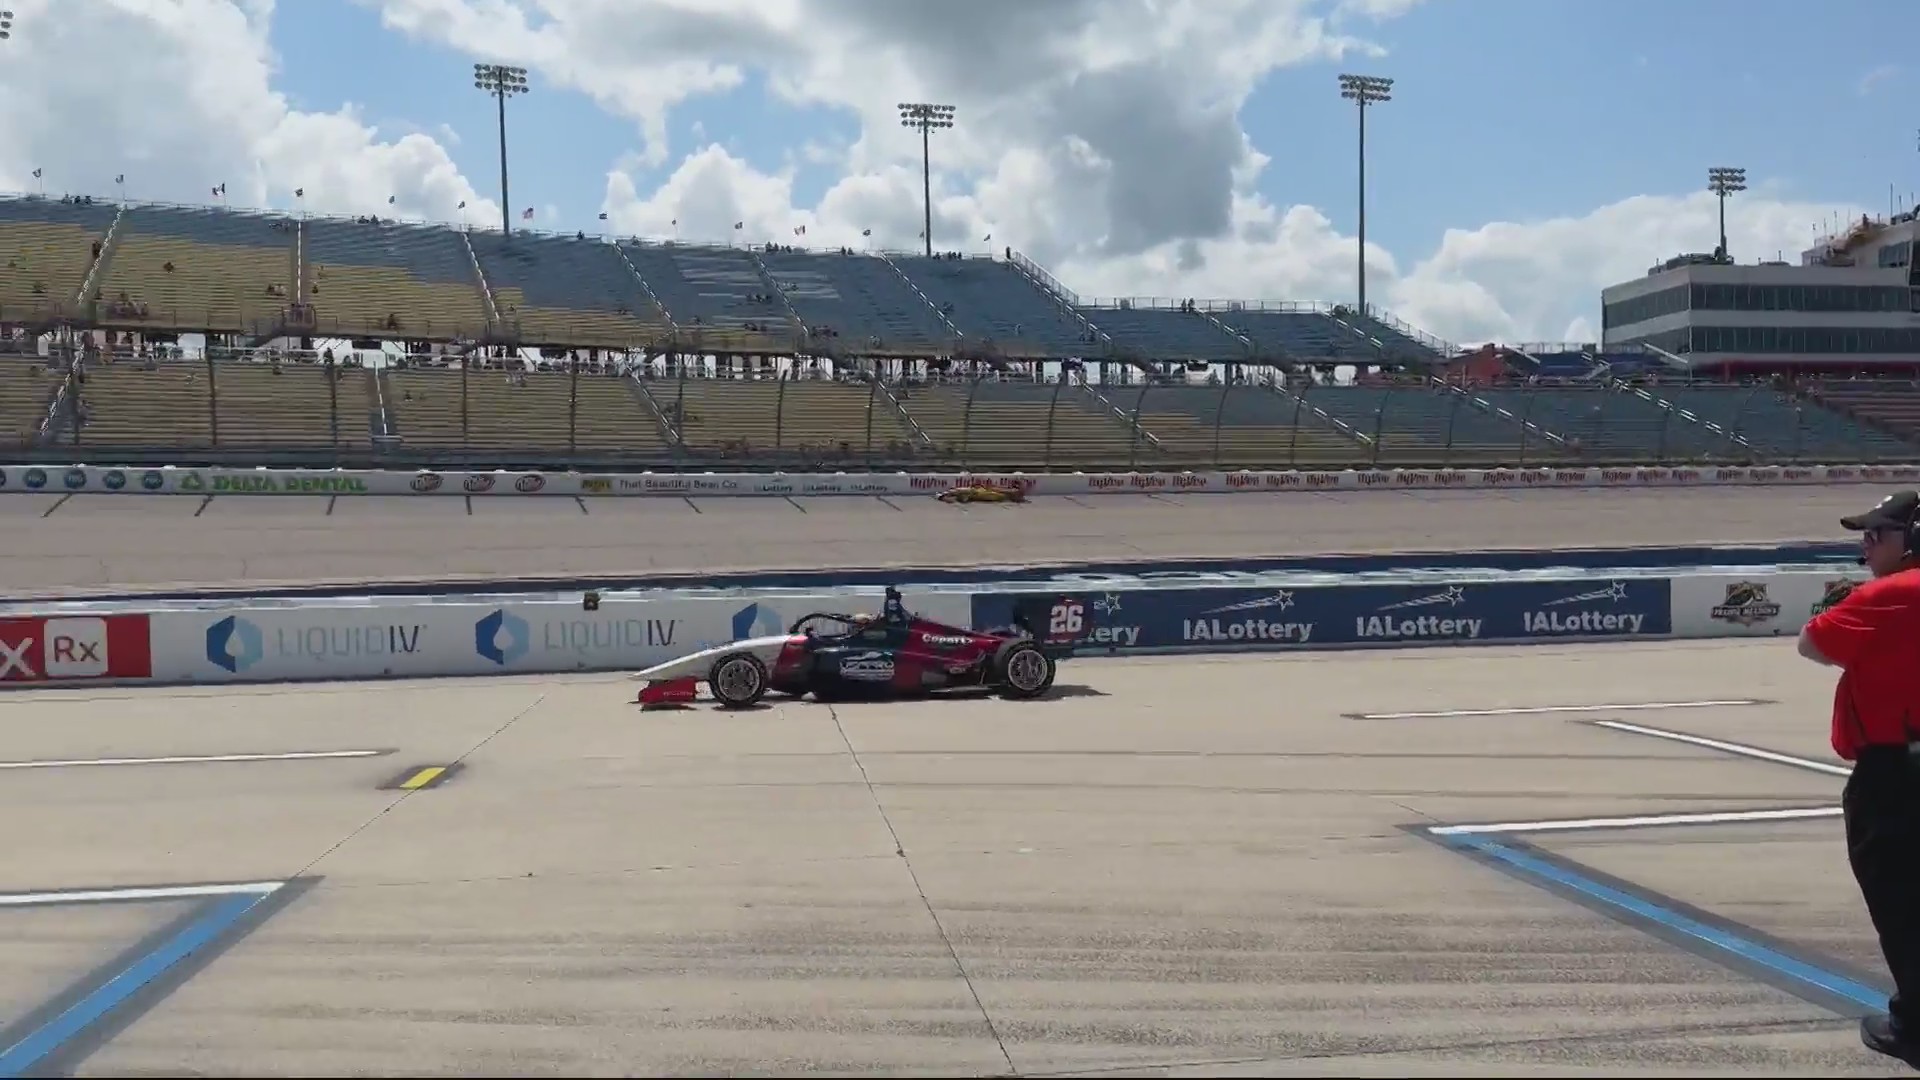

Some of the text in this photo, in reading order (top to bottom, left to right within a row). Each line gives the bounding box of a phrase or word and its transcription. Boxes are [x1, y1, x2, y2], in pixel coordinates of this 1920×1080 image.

[213, 476, 368, 491] DELTA DENTAL
[620, 479, 641, 488] That
[646, 479, 689, 489] Beautiful
[694, 479, 719, 488] Bean
[1050, 604, 1084, 634] 26
[1183, 619, 1313, 642] IALottery
[1356, 615, 1481, 638] IALottery
[1523, 610, 1644, 633] IALottery
[54, 635, 100, 662] Rx
